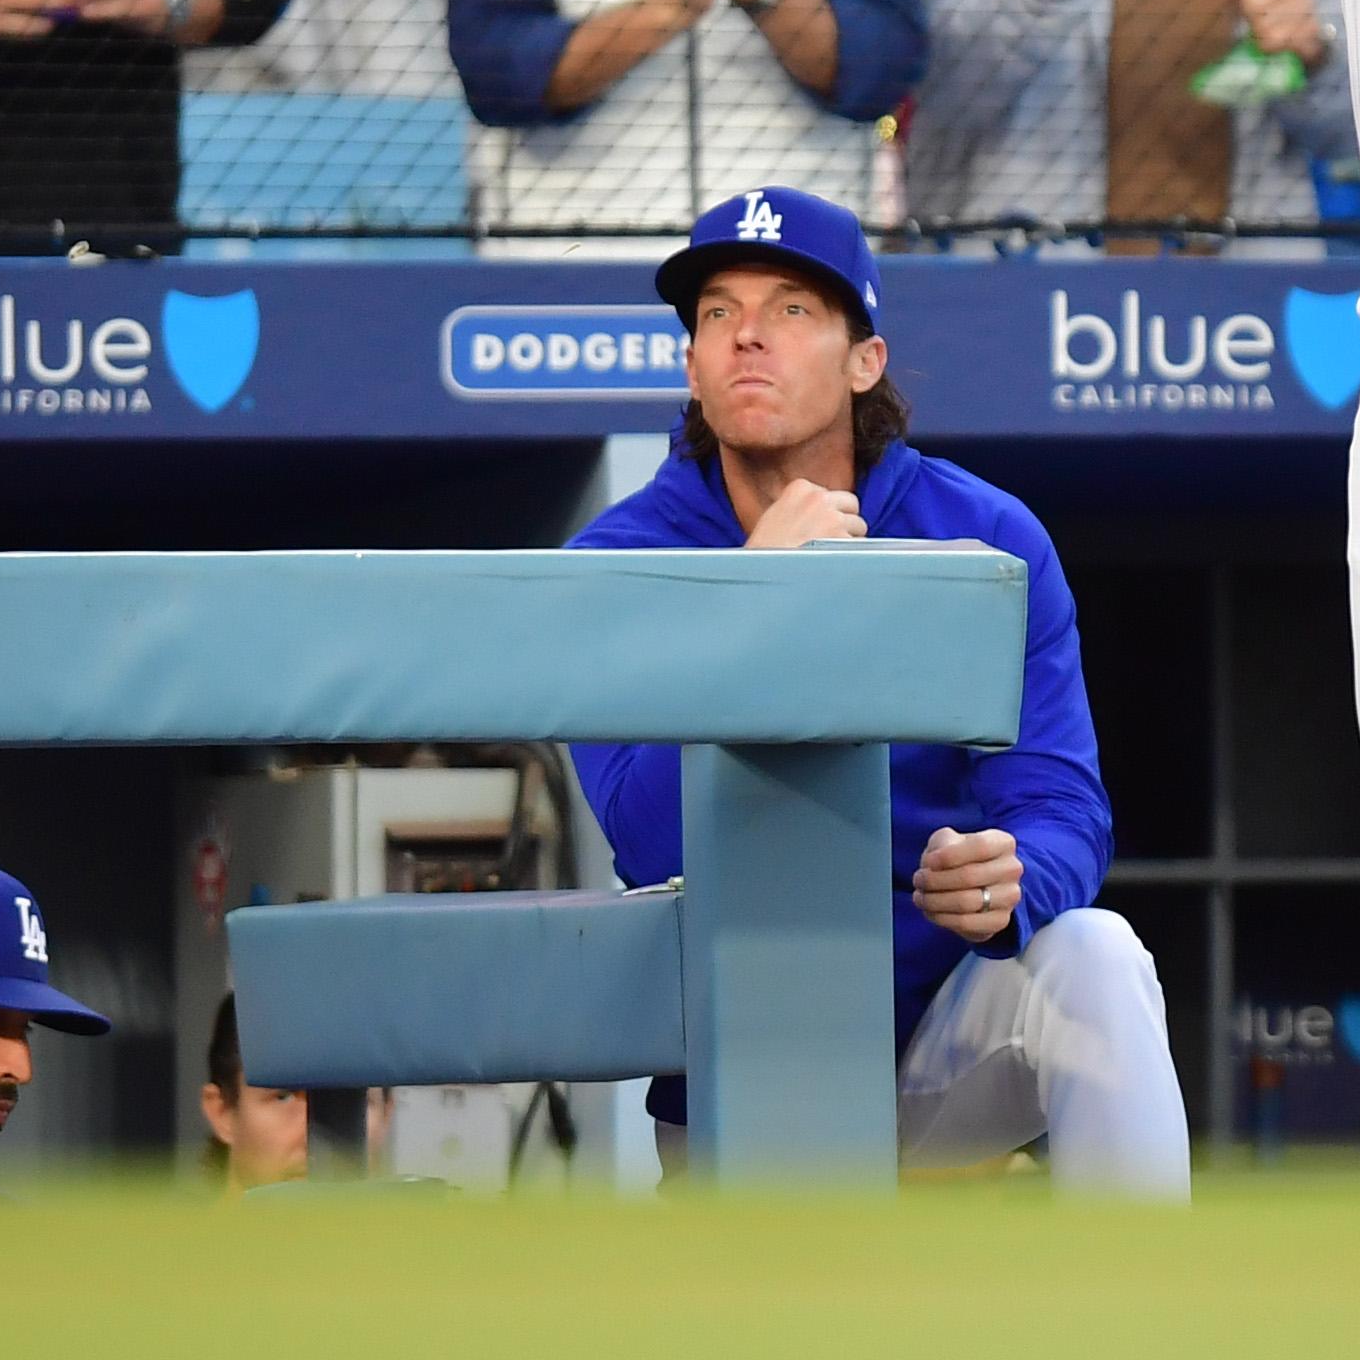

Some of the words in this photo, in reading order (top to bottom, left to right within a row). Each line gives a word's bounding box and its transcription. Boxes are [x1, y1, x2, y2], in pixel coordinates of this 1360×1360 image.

[736, 190, 783, 241] LA
[1051, 289, 1275, 382] blue
[1051, 384, 1276, 414] CALIFORNIA
[14, 896, 49, 963] LA
